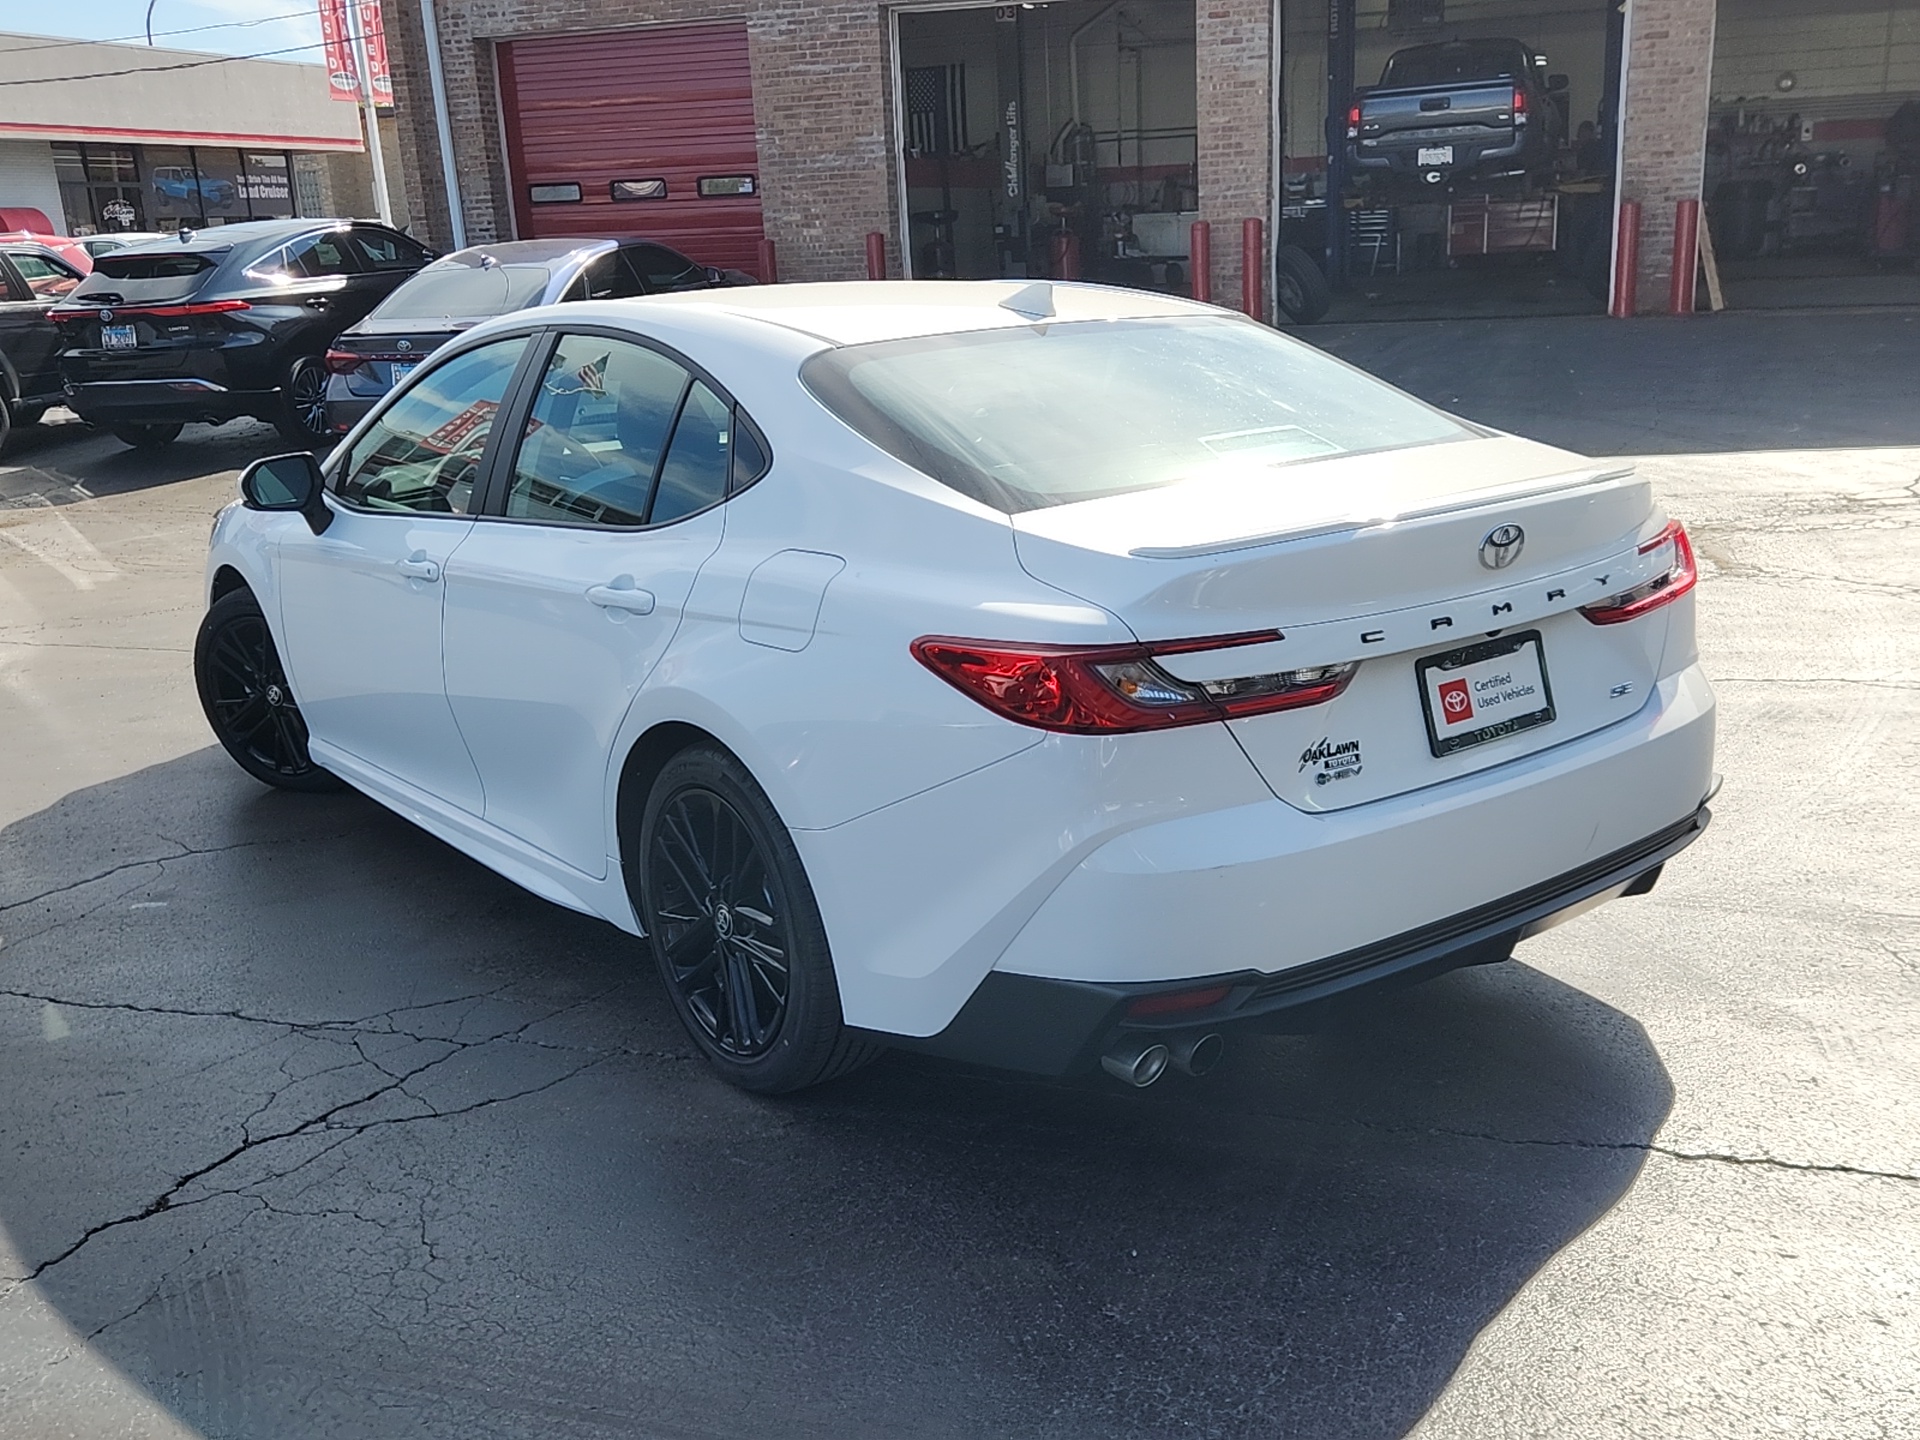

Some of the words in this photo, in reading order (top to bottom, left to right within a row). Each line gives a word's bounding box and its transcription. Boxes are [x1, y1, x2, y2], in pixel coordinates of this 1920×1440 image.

[996, 5, 1015, 19] 03
[321, 3, 337, 69] USED
[362, 8, 379, 72] USED
[1005, 100, 1016, 126] Lifts
[1004, 128, 1019, 197] Challenger
[238, 185, 260, 198] Land
[260, 185, 288, 198] Cruiser
[1360, 574, 1610, 643] CAMRY
[1474, 672, 1512, 692] Certified
[1610, 680, 1634, 699] SE
[1477, 693, 1501, 709] Used
[1500, 684, 1535, 702] Vehicles
[1474, 719, 1519, 742] TOYOTA
[1328, 755, 1356, 768] TOYOTA
